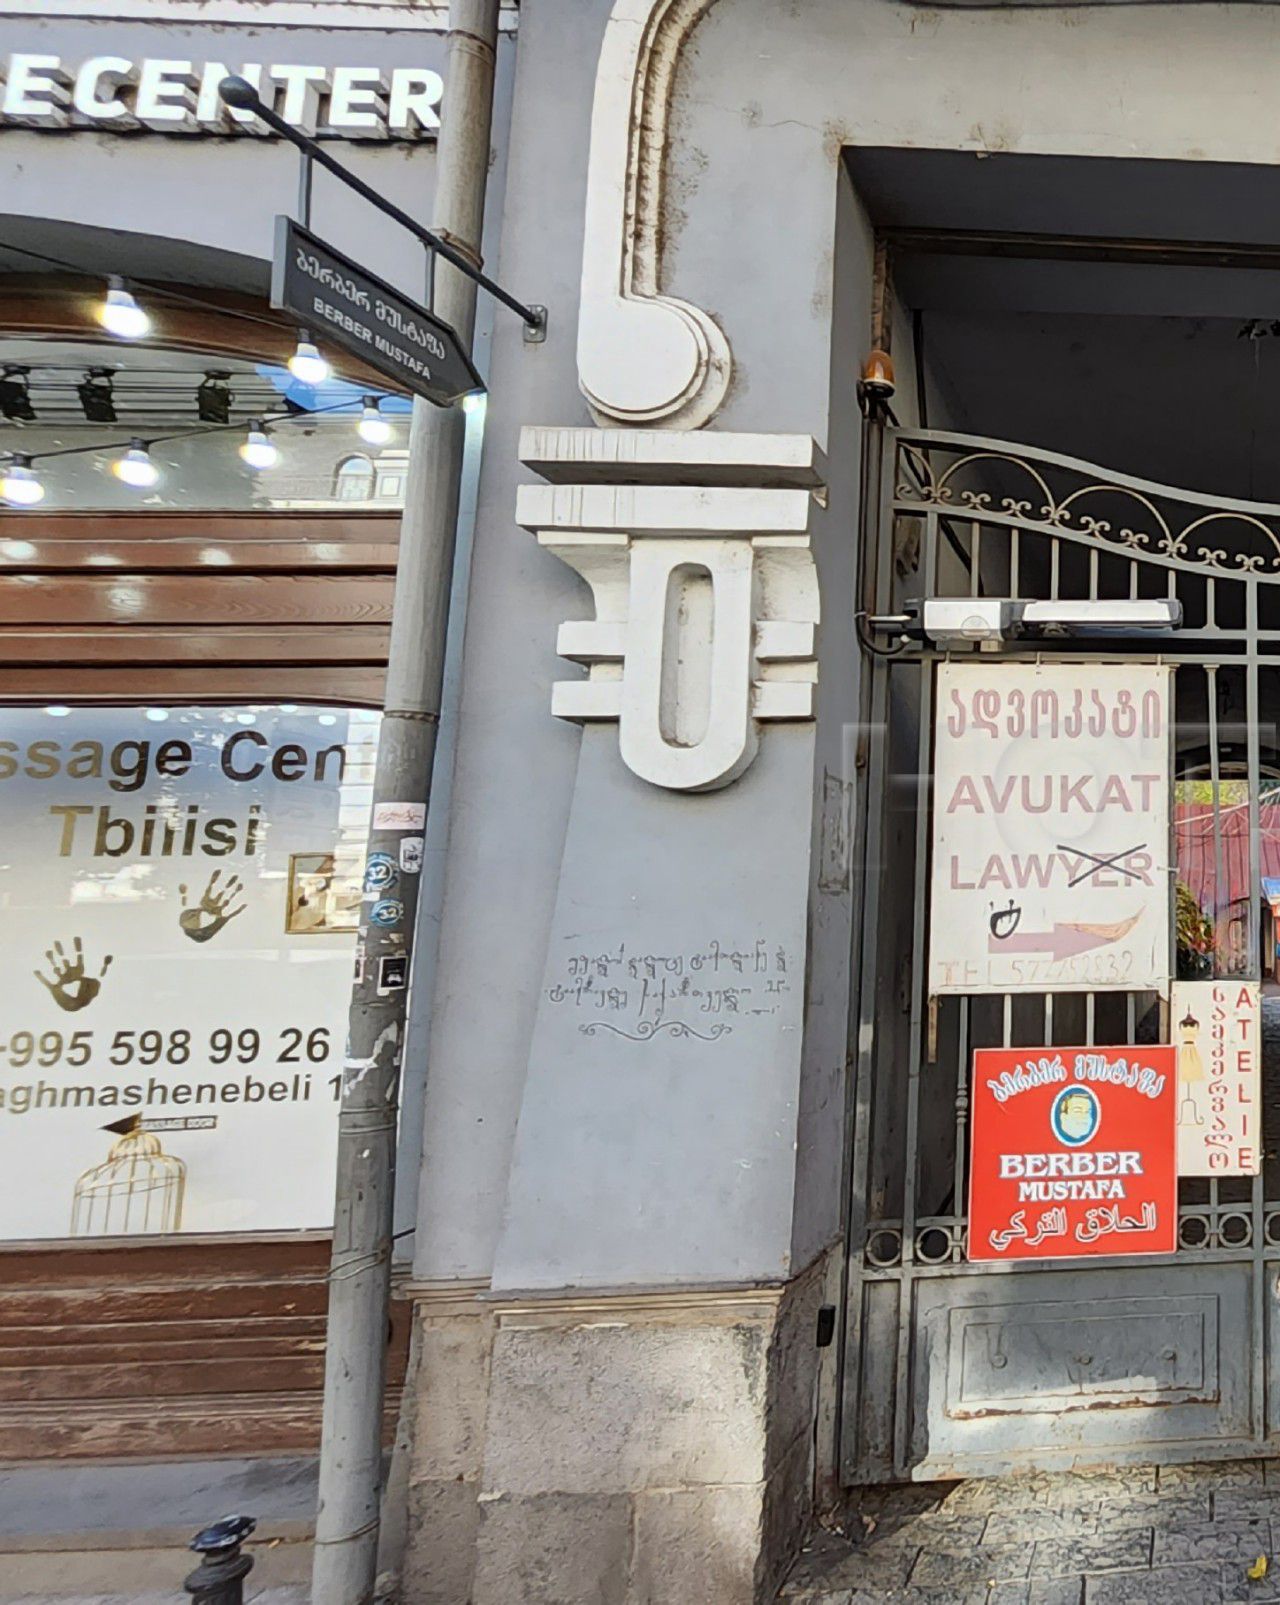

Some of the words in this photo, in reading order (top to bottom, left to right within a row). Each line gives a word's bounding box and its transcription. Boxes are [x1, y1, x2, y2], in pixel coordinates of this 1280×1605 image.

[296, 248, 371, 312] ბერბერ
[374, 300, 446, 360] მუსტაფა
[313, 297, 373, 344] BERBER
[374, 334, 431, 380] MUSTAFA
[947, 688, 1161, 739] ადვოკატი
[946, 774, 1161, 814] AVUKAT
[50, 804, 262, 857] Tbilisi
[367, 865, 388, 881] 32
[950, 853, 1155, 890] LAWYER
[109, 1028, 192, 1066] 598
[208, 1028, 261, 1064] 99
[276, 1027, 331, 1063] 26
[0, 1073, 311, 1115] ghmashenebeli
[987, 1054, 1067, 1102] ბერბერ
[1235, 987, 1252, 1169] ATELIE
[999, 1151, 1143, 1179] BERBER
[1018, 1180, 1126, 1203] MUSTAFA
[988, 1206, 1068, 1252] التركي
[1075, 1202, 1157, 1242] الحلاق
